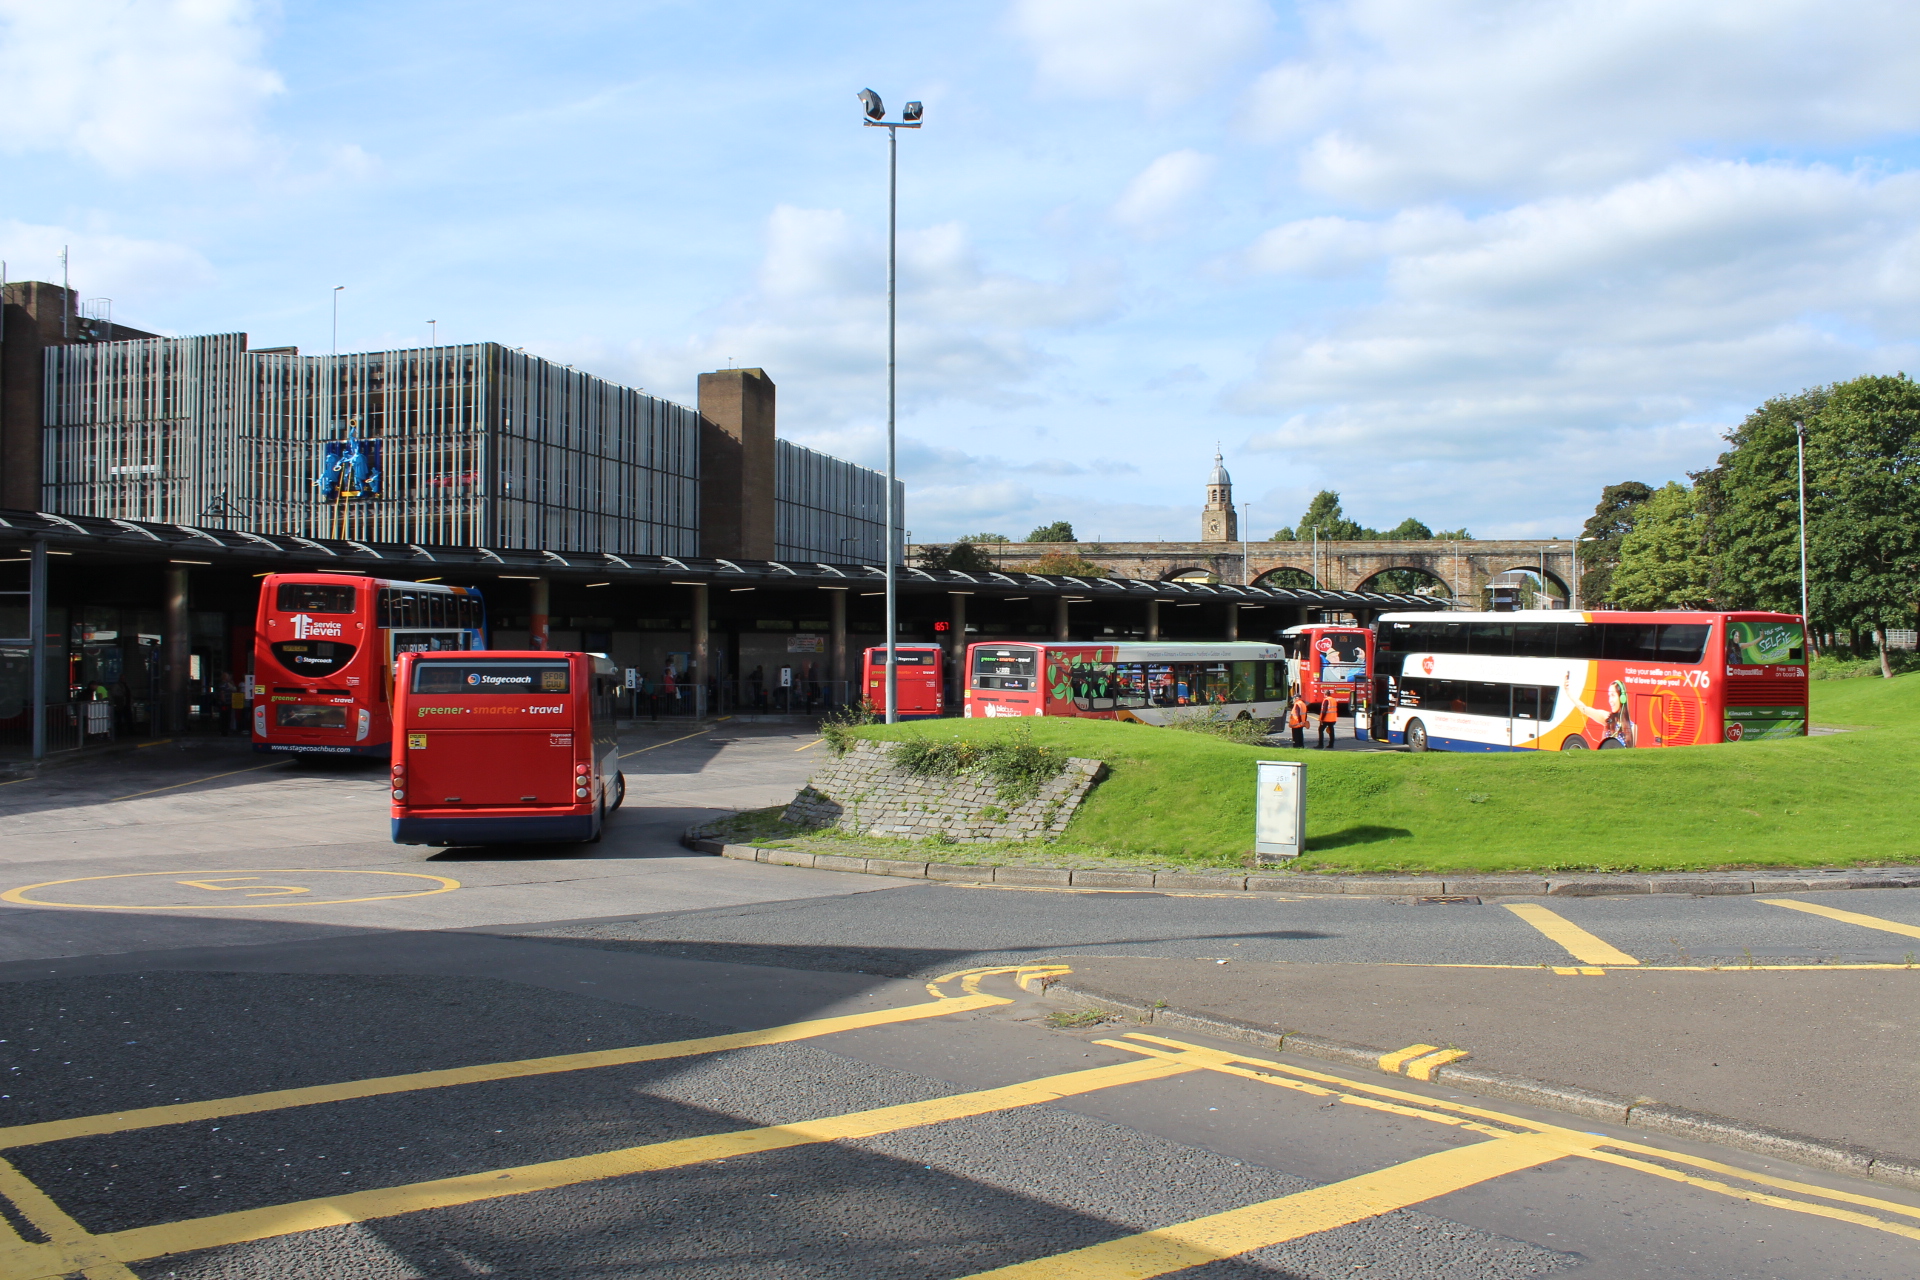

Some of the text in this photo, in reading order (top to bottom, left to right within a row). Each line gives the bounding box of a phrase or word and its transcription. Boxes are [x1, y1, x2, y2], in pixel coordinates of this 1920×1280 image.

[302, 626, 341, 636] Eleven
[481, 675, 532, 685] Stagecoach
[1683, 670, 1710, 688] X76
[418, 704, 563, 717] greener smarter travel
[1728, 729, 1740, 737] X76
